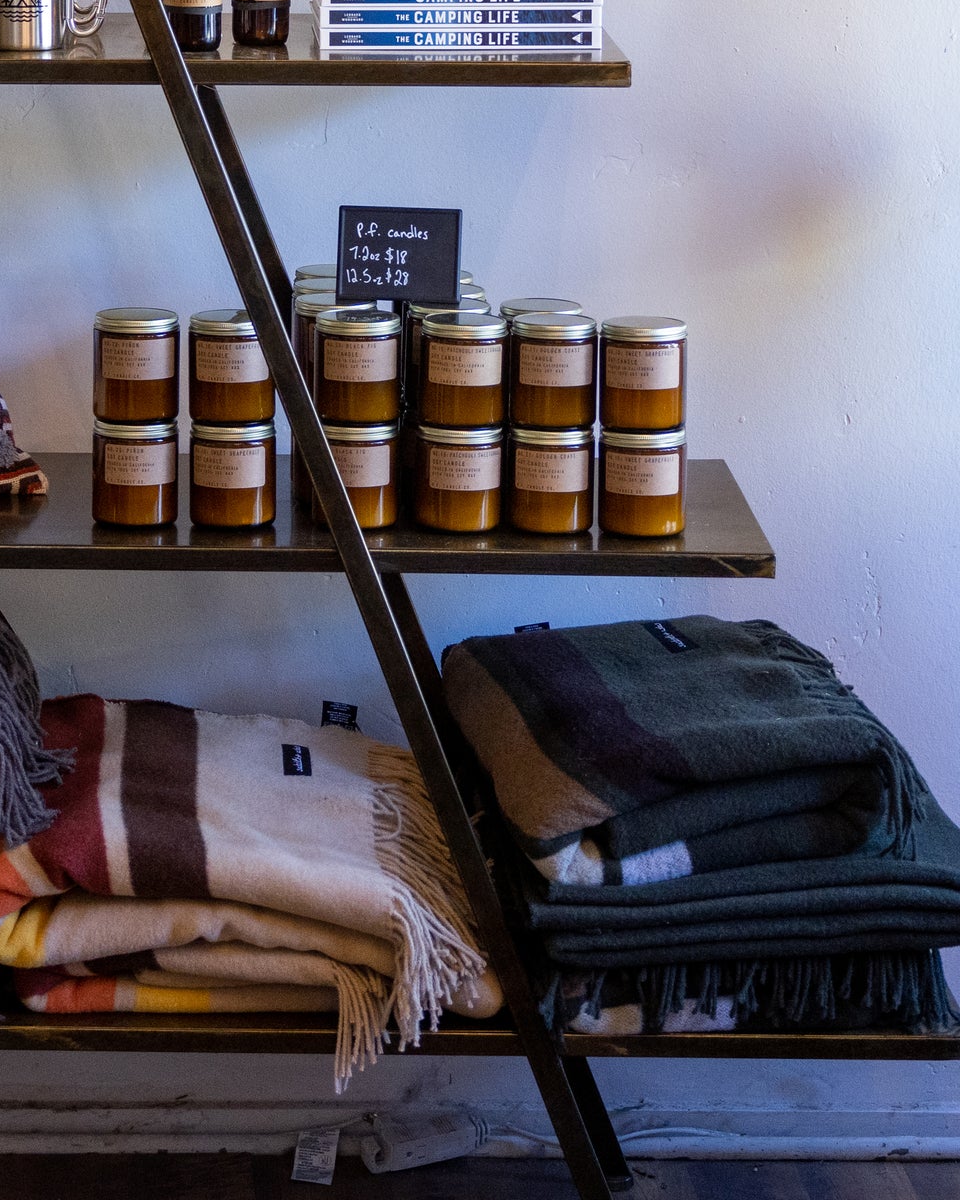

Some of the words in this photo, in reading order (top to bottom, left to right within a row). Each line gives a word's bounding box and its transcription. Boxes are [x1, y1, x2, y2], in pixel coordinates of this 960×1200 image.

[395, 13, 410, 21] THE
[414, 11, 483, 24] CAMPING
[488, 10, 519, 23] LIFE
[395, 35, 410, 43] THE
[414, 32, 483, 45] CAMPING
[488, 32, 519, 44] LIFE
[388, 224, 428, 240] candles
[384, 247, 407, 264] $18
[385, 268, 409, 286] $28
